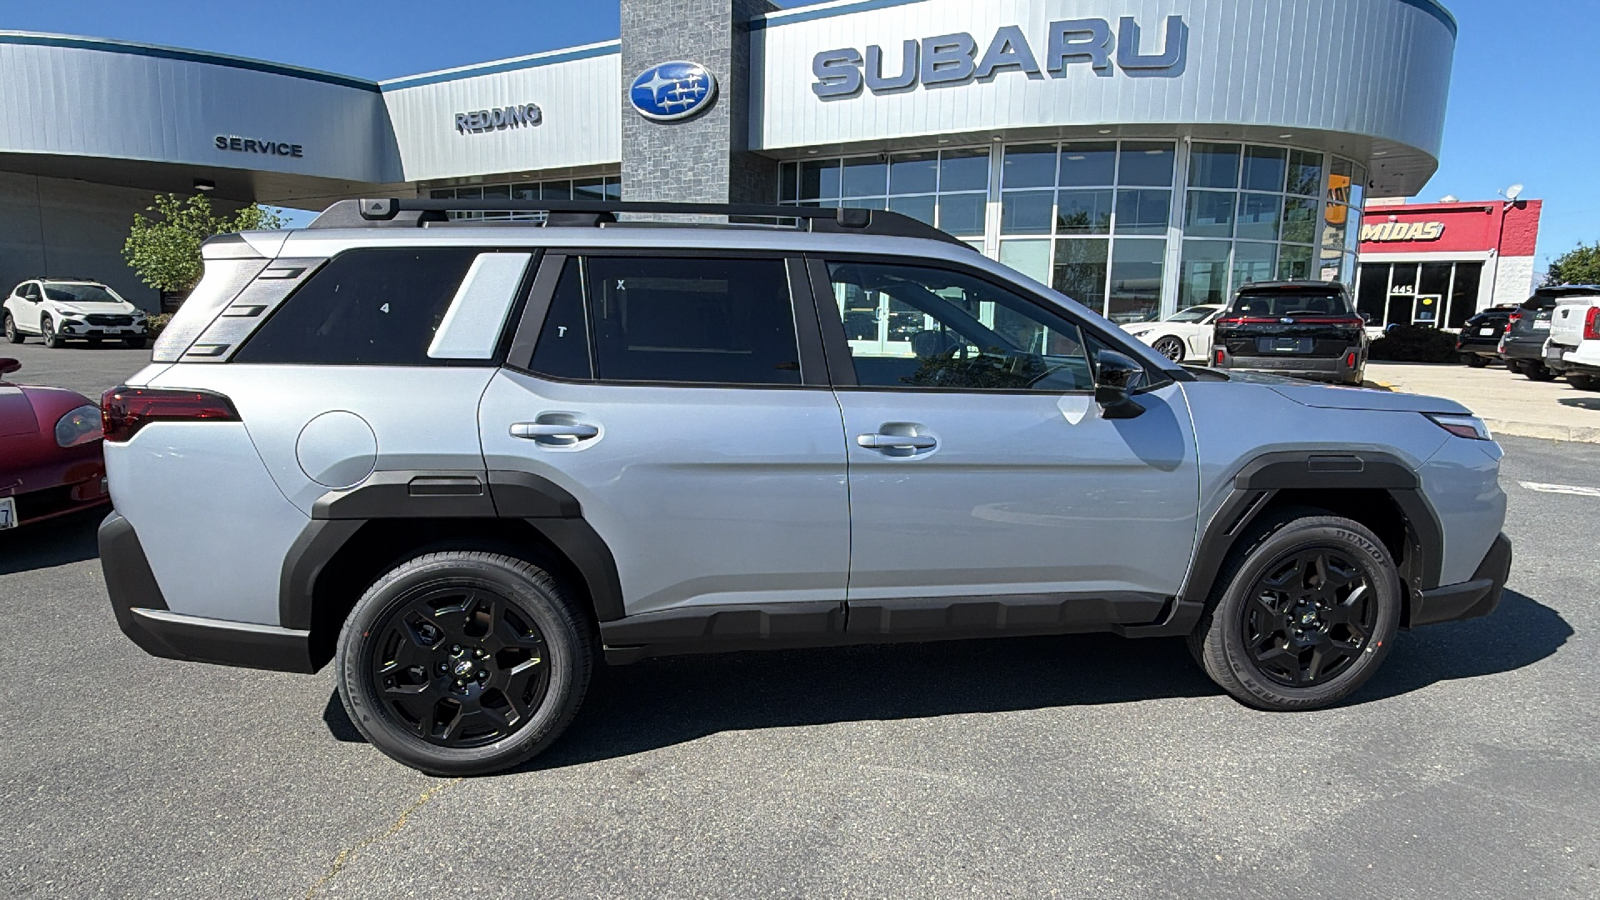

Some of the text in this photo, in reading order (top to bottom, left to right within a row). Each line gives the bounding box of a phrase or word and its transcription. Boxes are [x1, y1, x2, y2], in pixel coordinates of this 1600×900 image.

[812, 15, 1187, 101] SUBARU
[454, 103, 542, 134] REDDING
[215, 136, 303, 157] SERVICE
[1359, 222, 1443, 242] MIDAS
[1392, 284, 1413, 294] 445
[1336, 529, 1390, 569] DUNLOP
